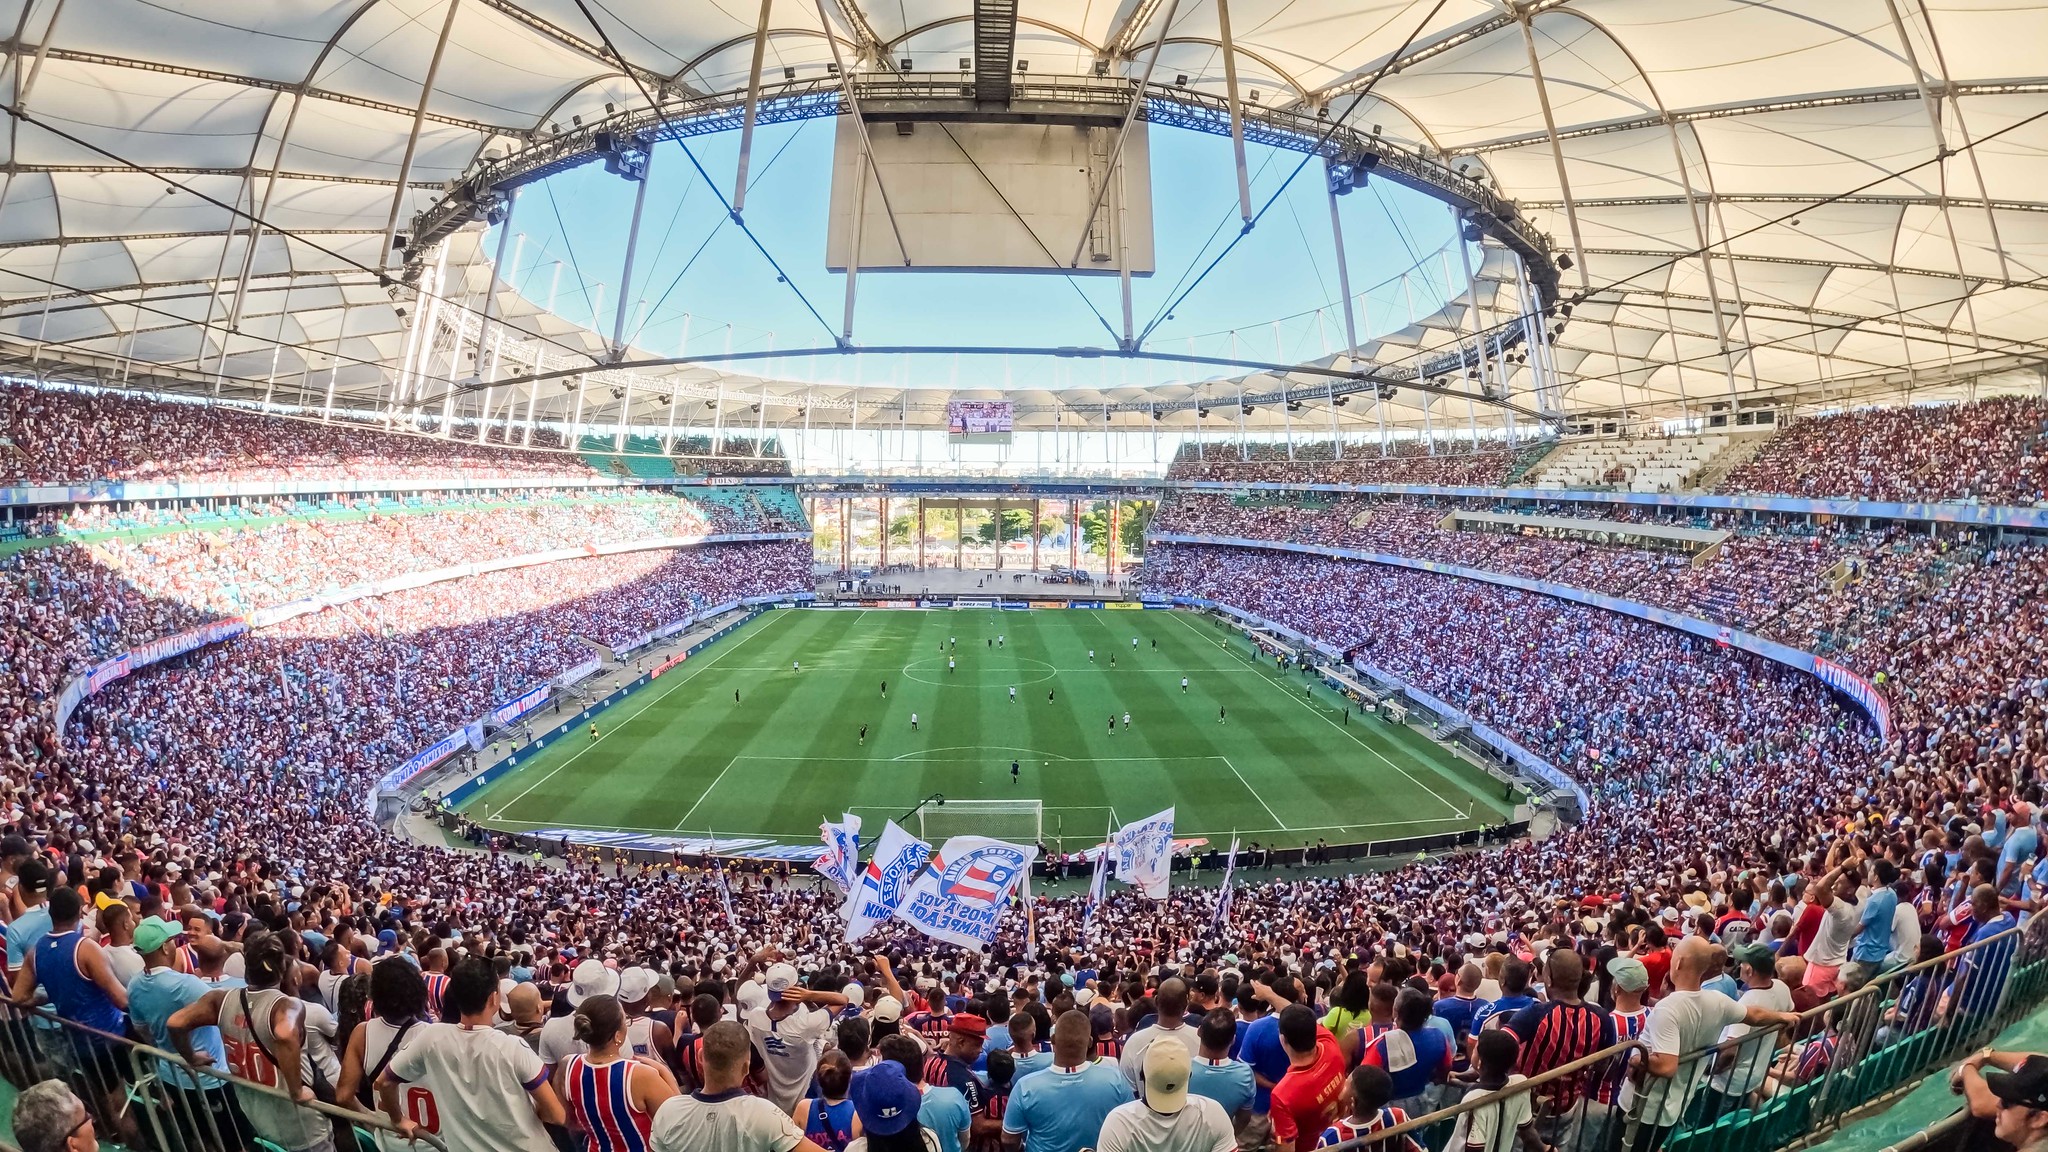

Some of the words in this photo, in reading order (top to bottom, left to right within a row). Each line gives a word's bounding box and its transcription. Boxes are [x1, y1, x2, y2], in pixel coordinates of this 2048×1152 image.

[1827, 665, 1866, 704] TORCIDA
[395, 761, 420, 784] UNIÃO
[420, 740, 454, 766] SINISTRA
[884, 849, 915, 902] ESPORTE
